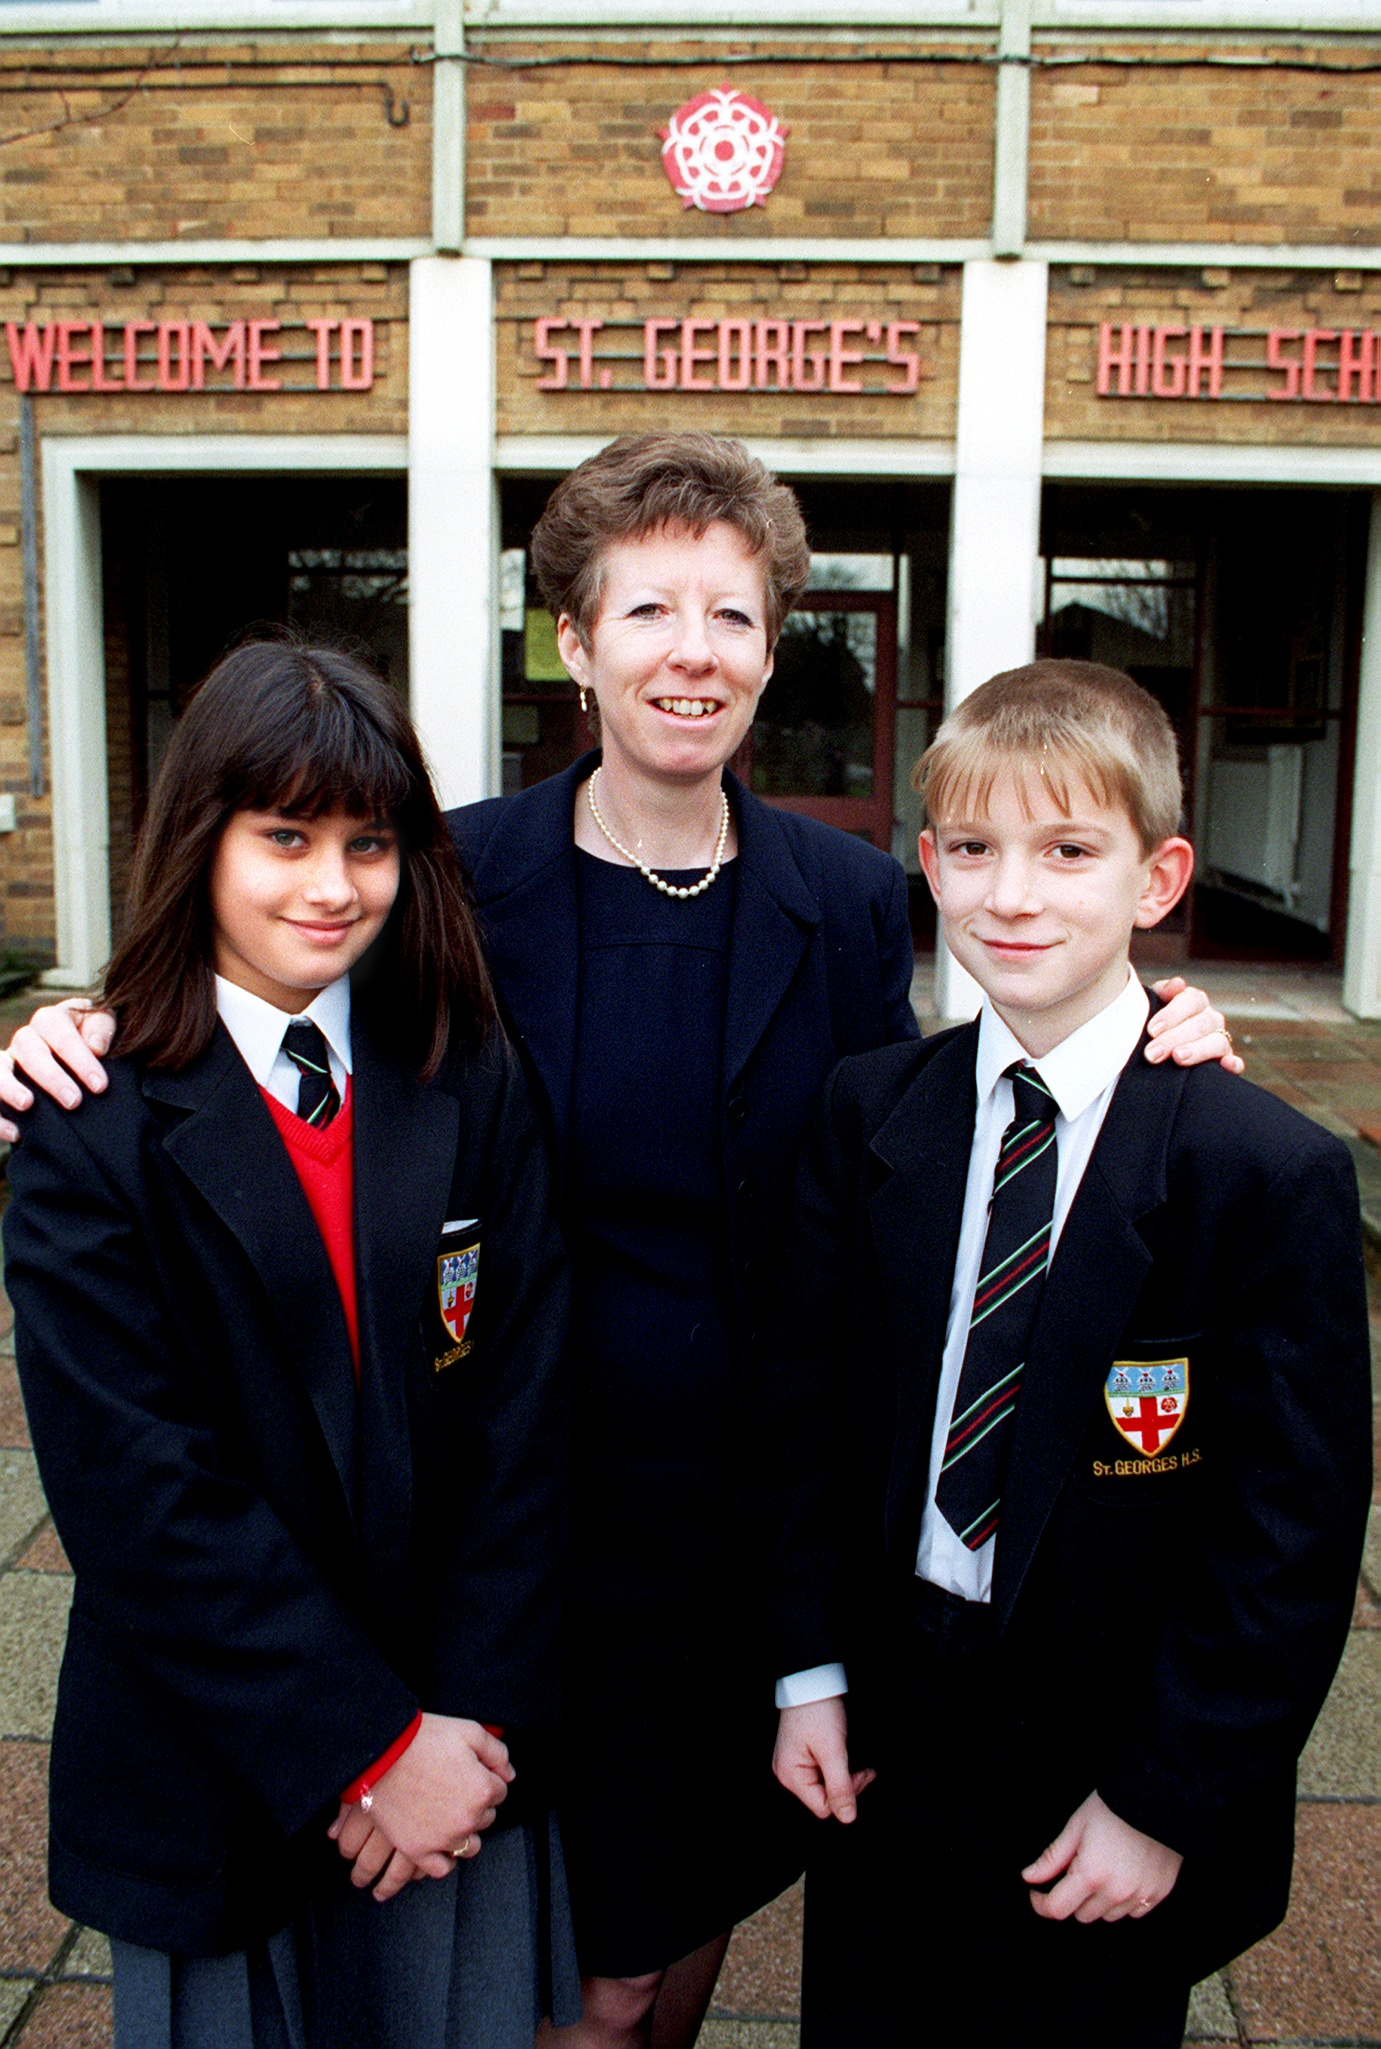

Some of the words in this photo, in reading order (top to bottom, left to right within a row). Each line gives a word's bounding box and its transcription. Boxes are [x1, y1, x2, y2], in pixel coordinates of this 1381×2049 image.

[6, 318, 283, 392] WELCOME
[307, 317, 374, 391] TO
[533, 317, 612, 391] ST.
[642, 318, 921, 393] GEORGE'S
[1098, 322, 1223, 398] HIGH
[1266, 328, 1381, 402] SCH
[1114, 1456, 1178, 1476] GEORGES
